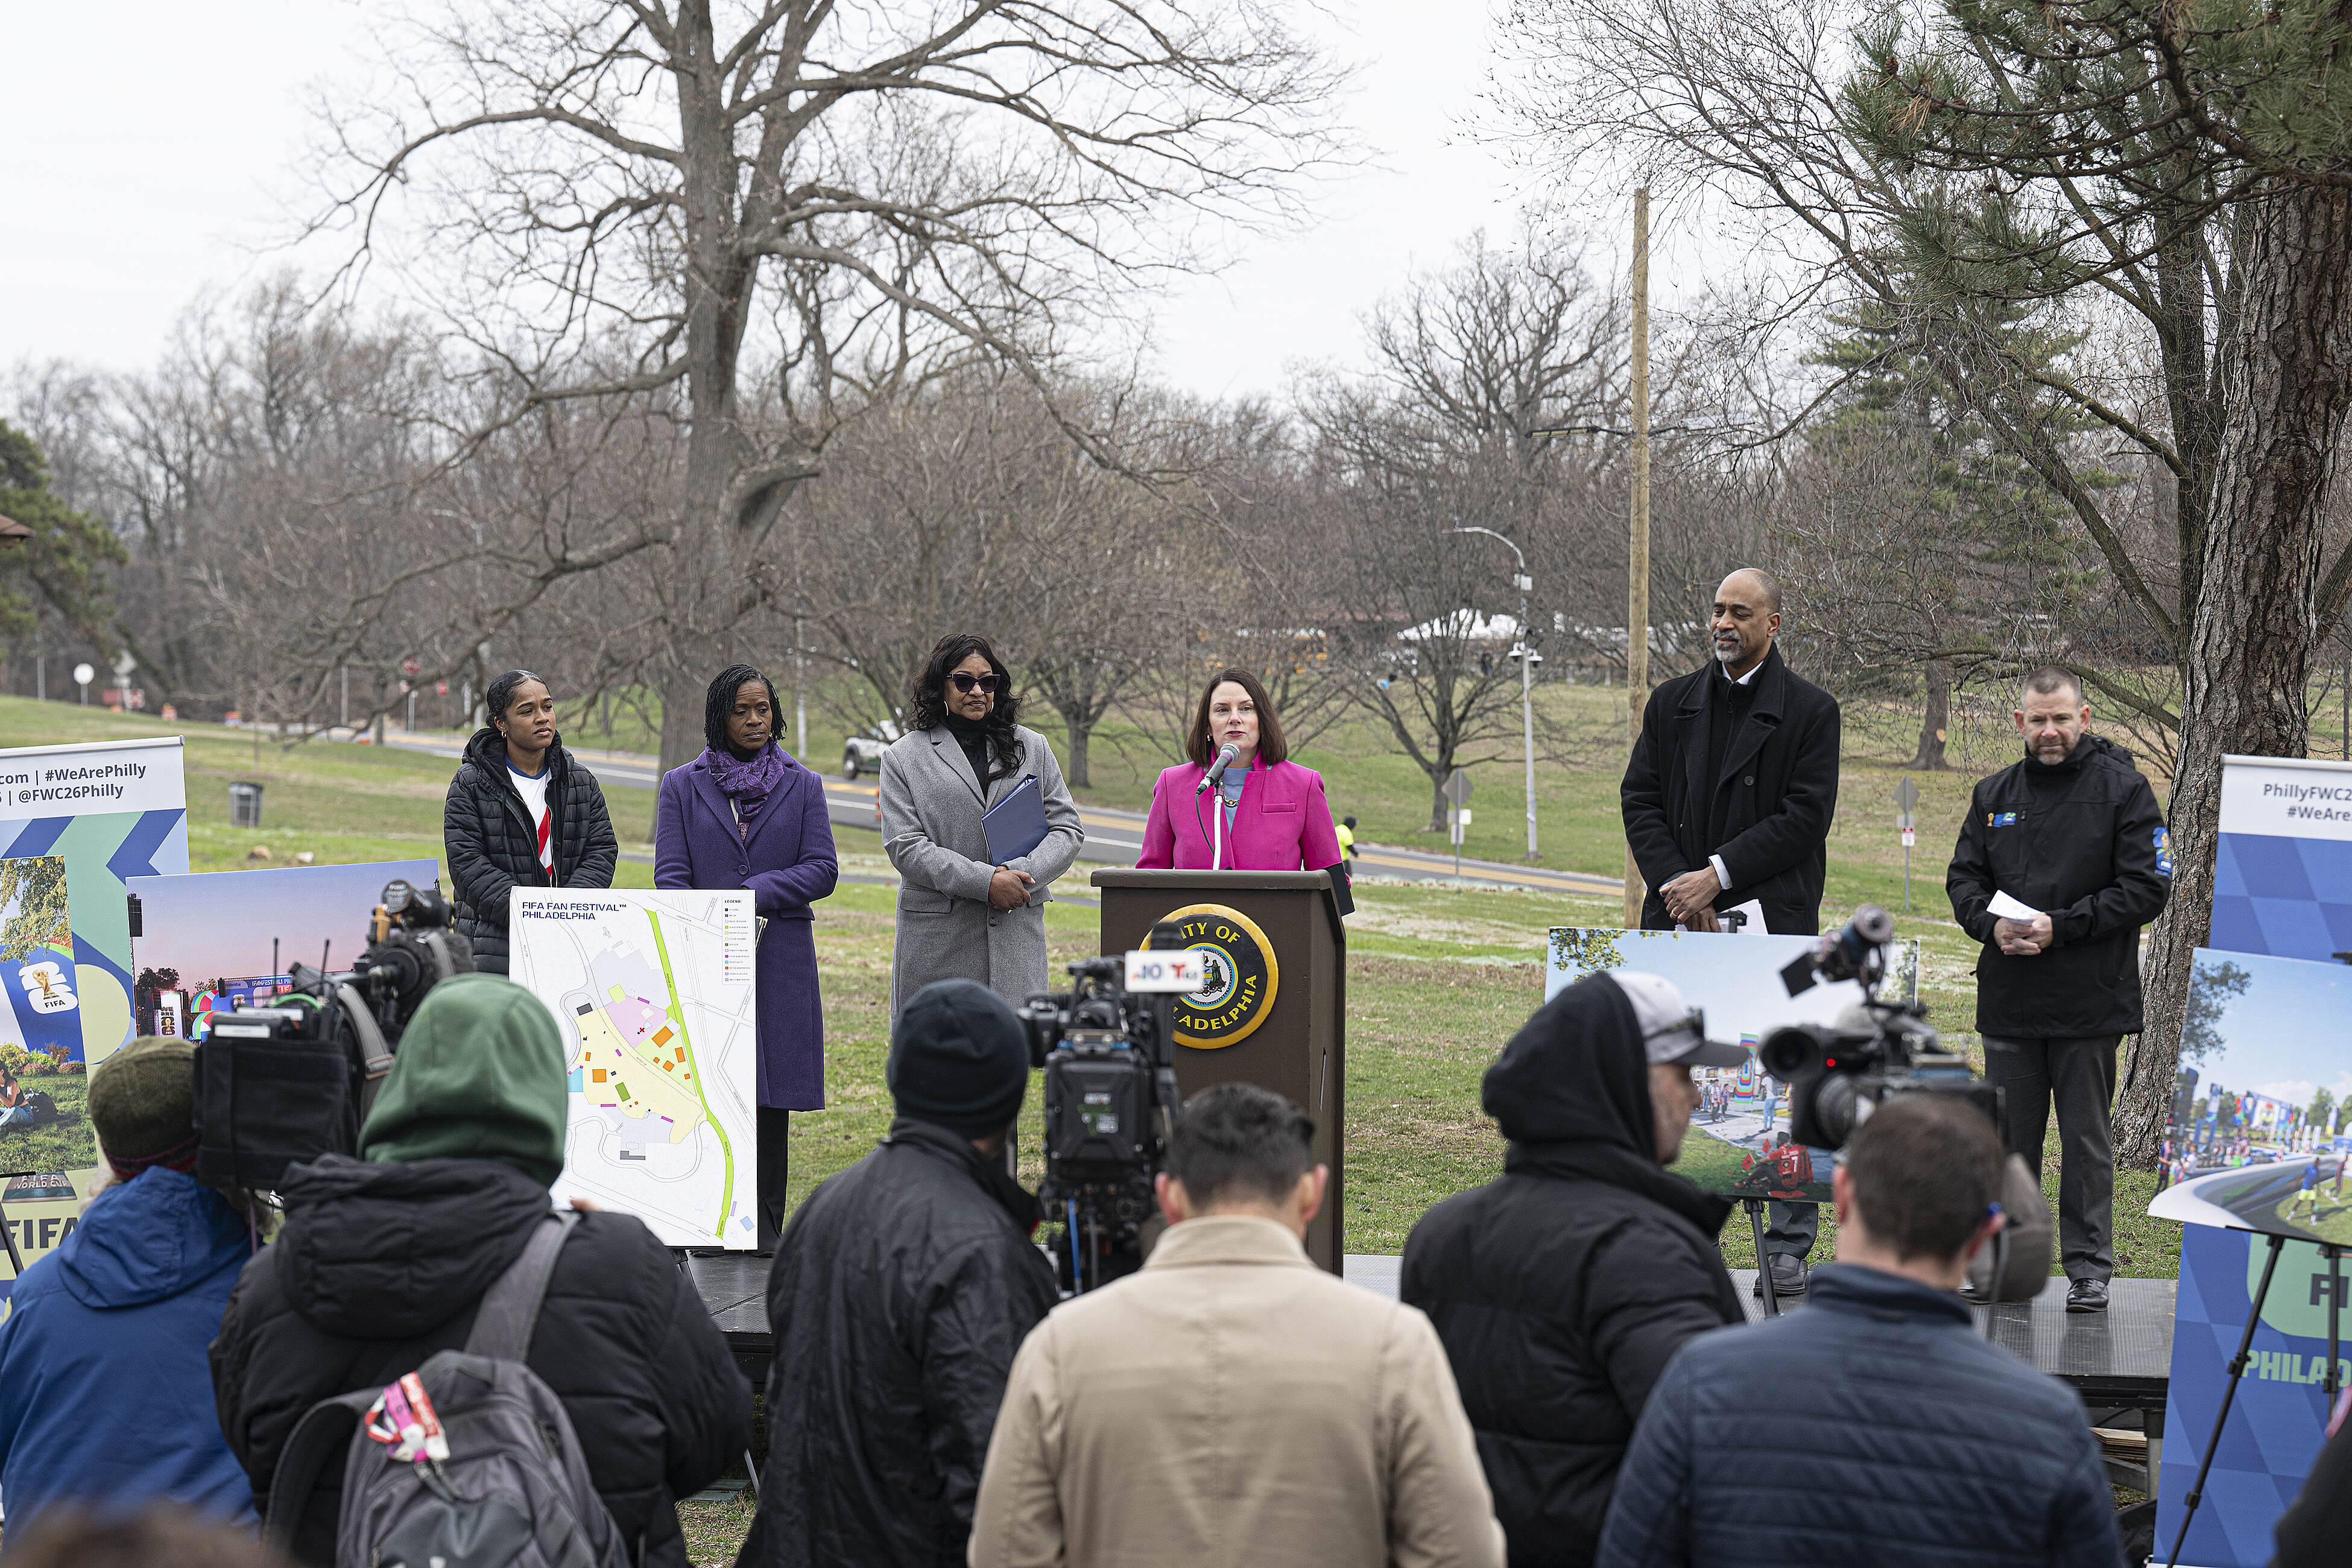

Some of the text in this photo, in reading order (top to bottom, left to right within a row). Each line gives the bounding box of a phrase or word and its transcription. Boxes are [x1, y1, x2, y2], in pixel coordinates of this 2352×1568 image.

[45, 763, 147, 782] #WeArePhilly
[19, 783, 124, 803] @FWC26Philly
[522, 911, 596, 920] PHILADELPHIA
[1180, 922, 1241, 943] ITY OF
[44, 999, 66, 1008] FIFA
[1173, 975, 1257, 1030] ADELPHIA
[1791, 1156, 1798, 1173] 7
